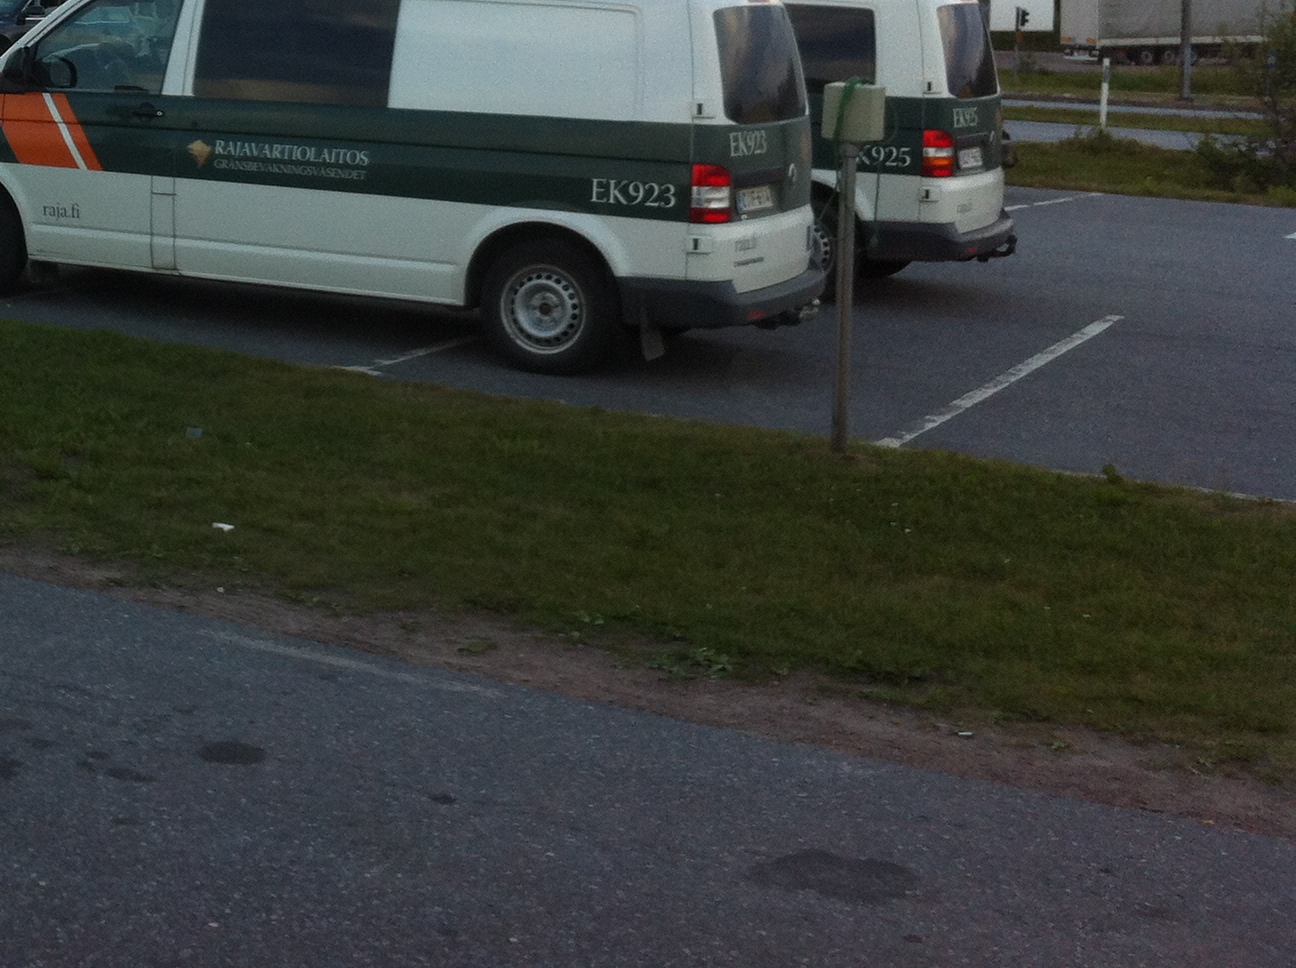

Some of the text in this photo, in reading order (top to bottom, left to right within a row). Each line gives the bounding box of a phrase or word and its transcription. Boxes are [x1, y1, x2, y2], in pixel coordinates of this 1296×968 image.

[953, 107, 978, 128] EK925
[214, 139, 370, 166] RAJAVARTIOLAITOS
[730, 131, 767, 157] EK923
[855, 144, 911, 167] K925
[591, 178, 676, 208] EK923
[43, 203, 80, 221] raja.fi
